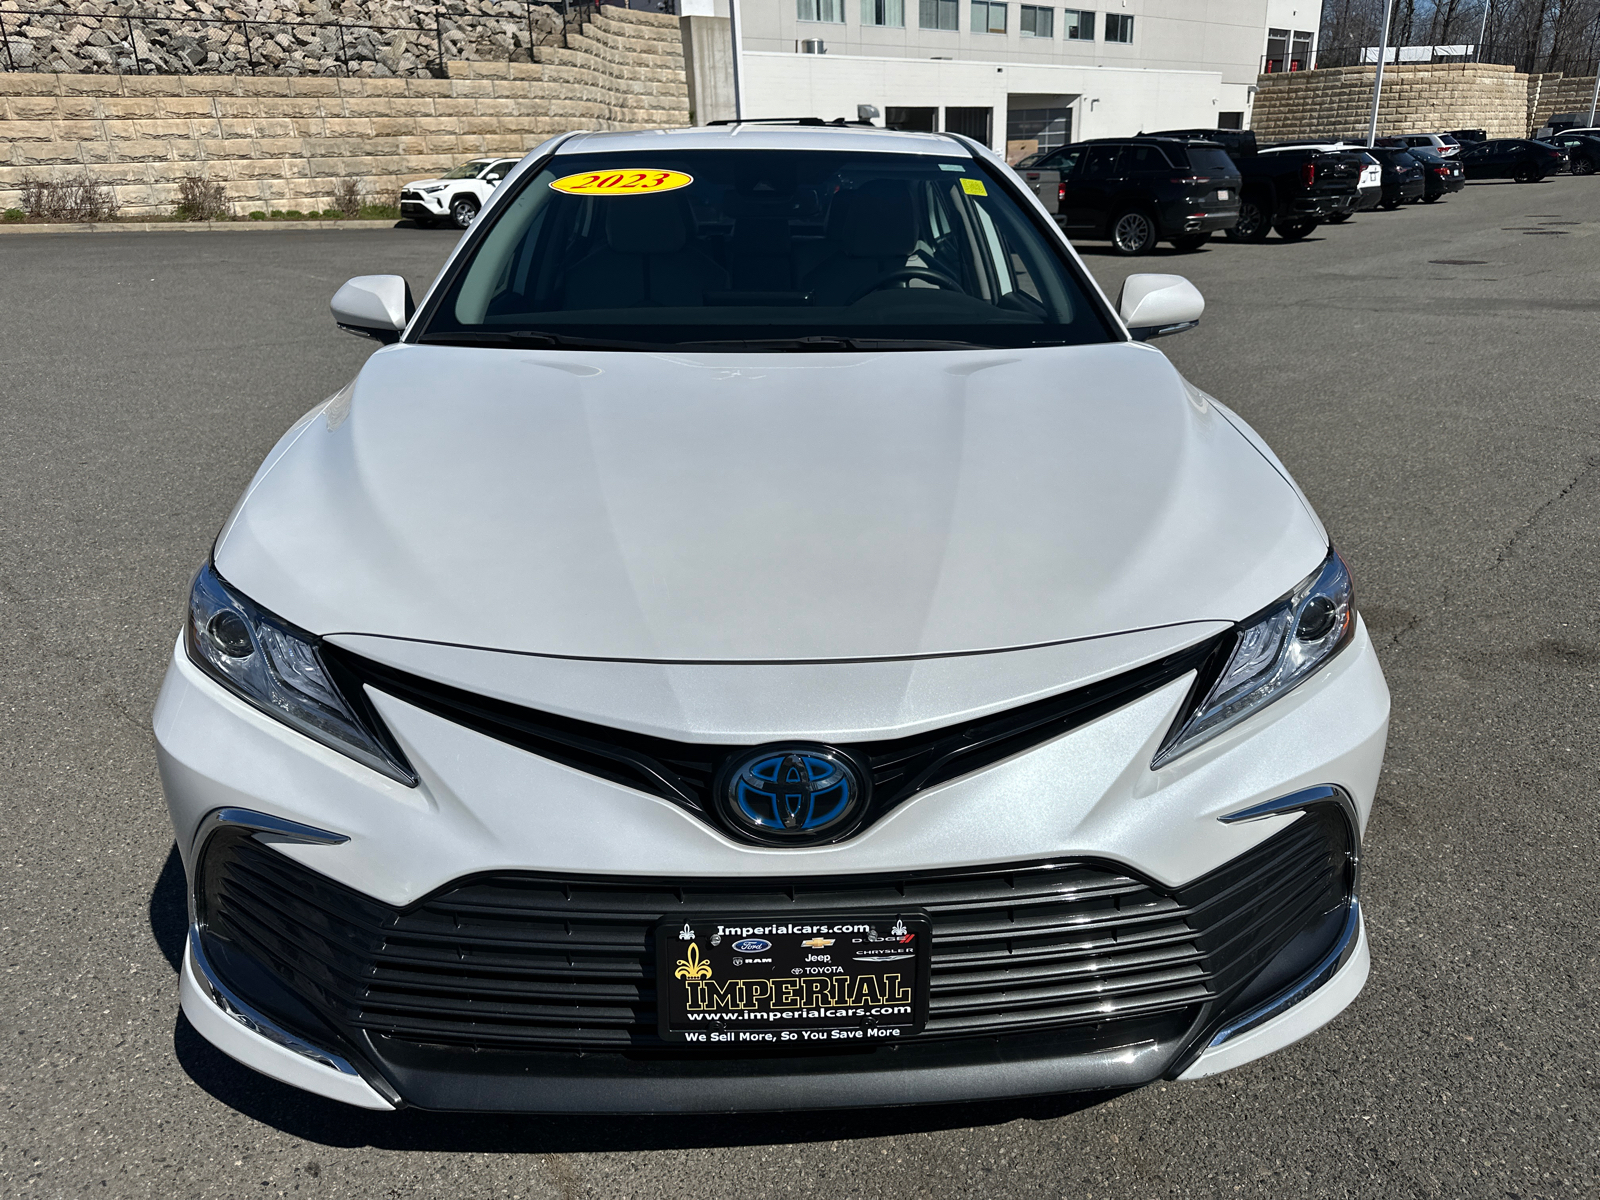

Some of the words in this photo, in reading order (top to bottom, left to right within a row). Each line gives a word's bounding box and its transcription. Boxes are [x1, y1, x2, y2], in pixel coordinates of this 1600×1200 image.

[570, 173, 670, 189] 2023
[717, 924, 870, 937] Imperialcars.com
[741, 941, 763, 950] Ford
[805, 953, 831, 963] Jeep
[805, 966, 844, 974] TOYOTA
[685, 973, 911, 1011] IMPERIAL
[687, 1006, 911, 1021] www.imperialcars.com
[685, 1032, 707, 1042] We
[710, 1032, 735, 1041] Sell
[740, 1032, 777, 1042] More,
[781, 1031, 798, 1040] So
[802, 1030, 827, 1040] You
[831, 1029, 863, 1039] Save
[867, 1028, 900, 1037] More
